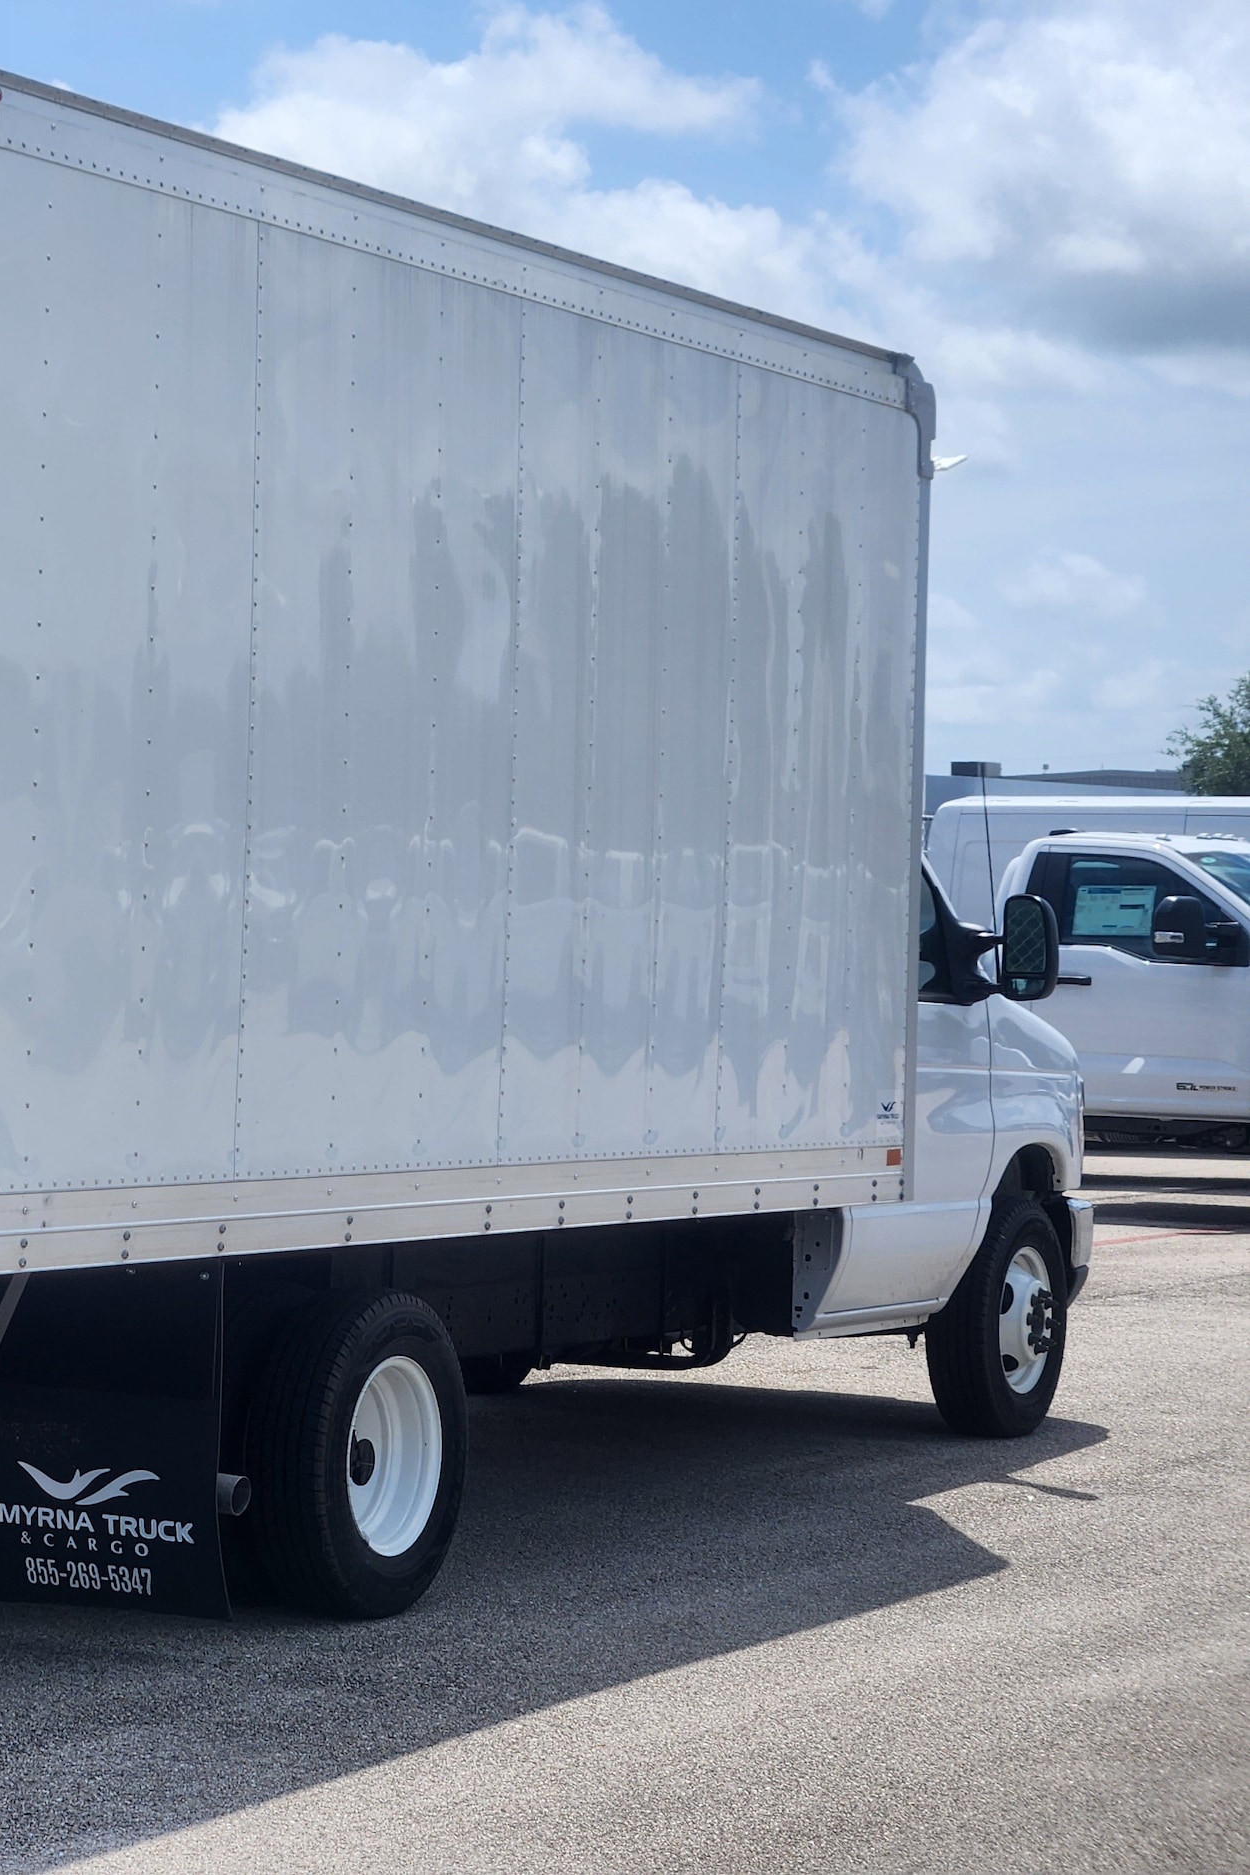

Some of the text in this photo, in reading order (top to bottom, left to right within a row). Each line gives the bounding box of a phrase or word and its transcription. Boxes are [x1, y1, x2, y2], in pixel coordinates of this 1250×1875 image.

[20, 1531, 149, 1557] & CARGO
[102, 1513, 195, 1544] TRUCK
[25, 1556, 151, 1596] 855-269-5347
